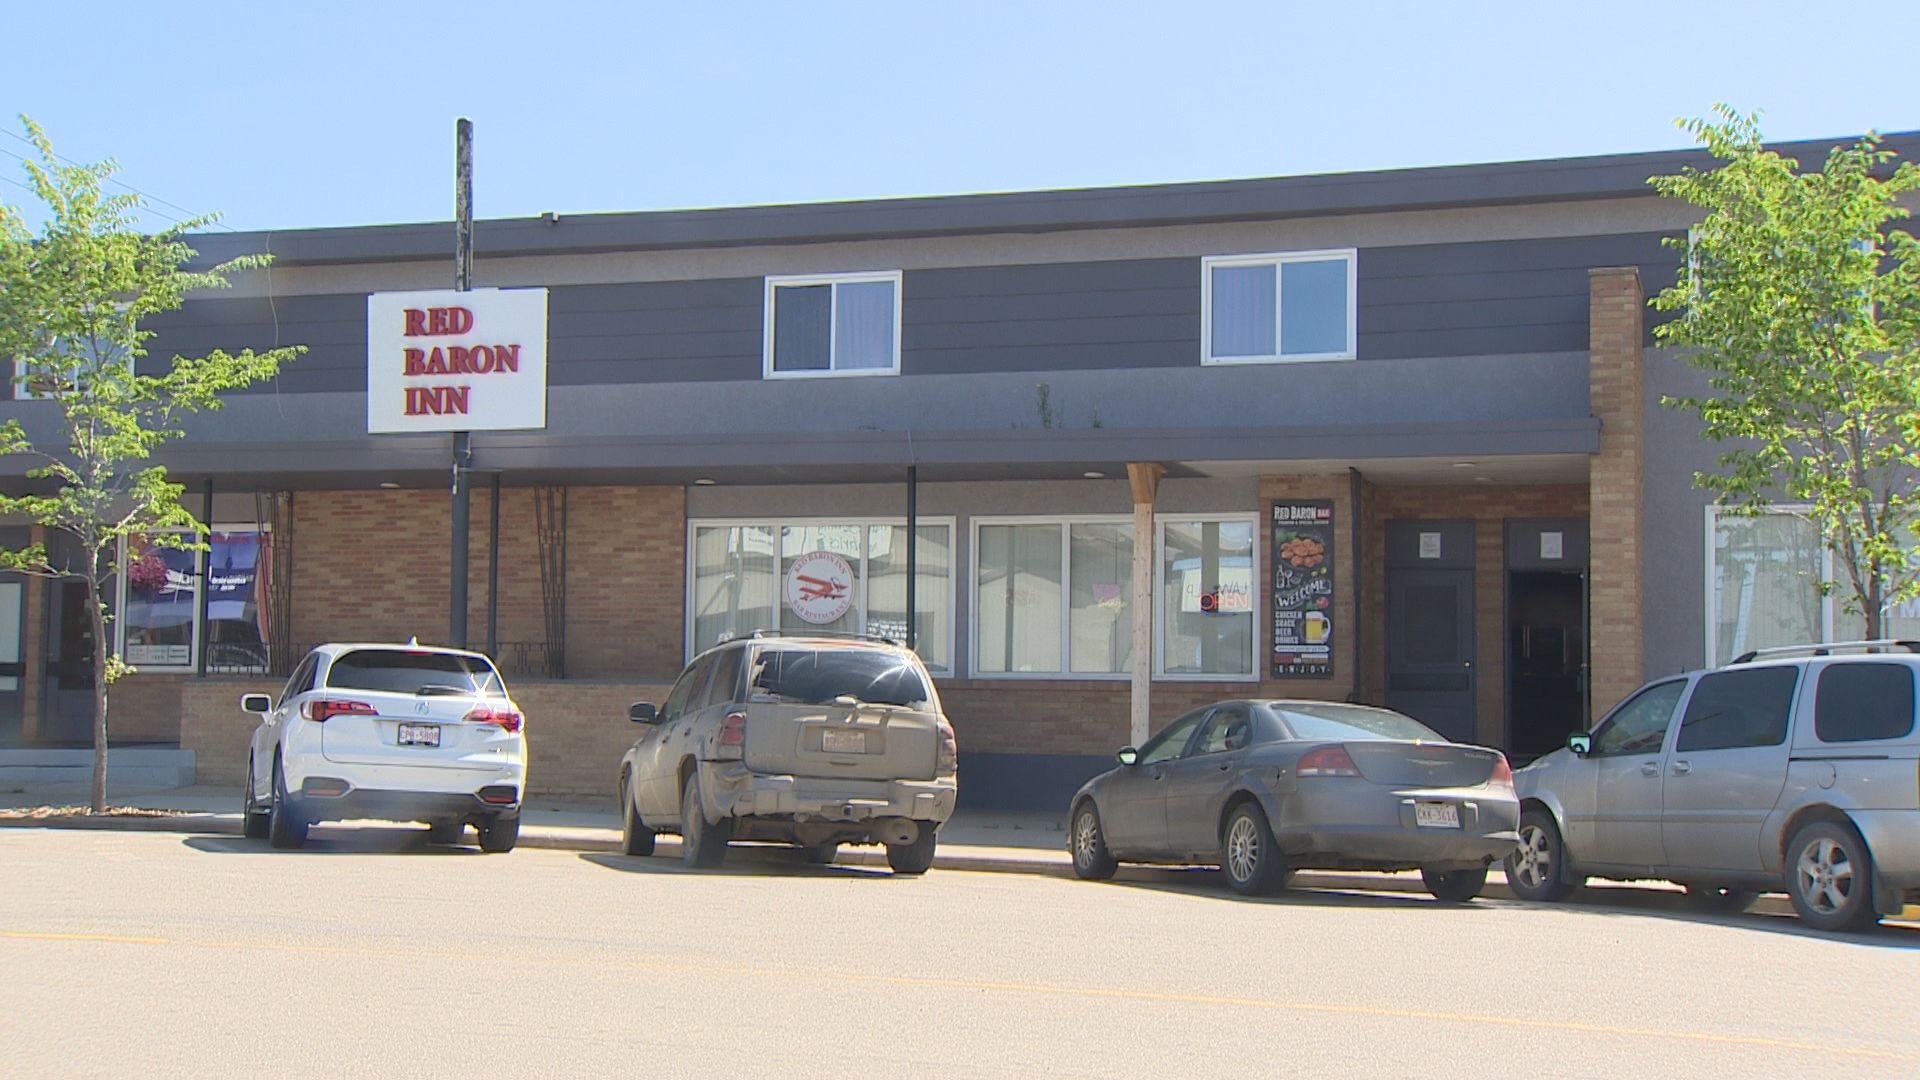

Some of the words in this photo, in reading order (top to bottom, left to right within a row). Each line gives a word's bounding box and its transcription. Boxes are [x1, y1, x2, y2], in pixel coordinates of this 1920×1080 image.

[403, 306, 474, 337] RED
[402, 344, 521, 376] BARON
[403, 386, 471, 416] INN
[1274, 505, 1290, 520] RED
[1291, 505, 1317, 520] BARON
[807, 551, 834, 562] BARON
[833, 559, 846, 574] INN
[1200, 592, 1249, 610] OPEN
[1278, 579, 1328, 607] WELCOME
